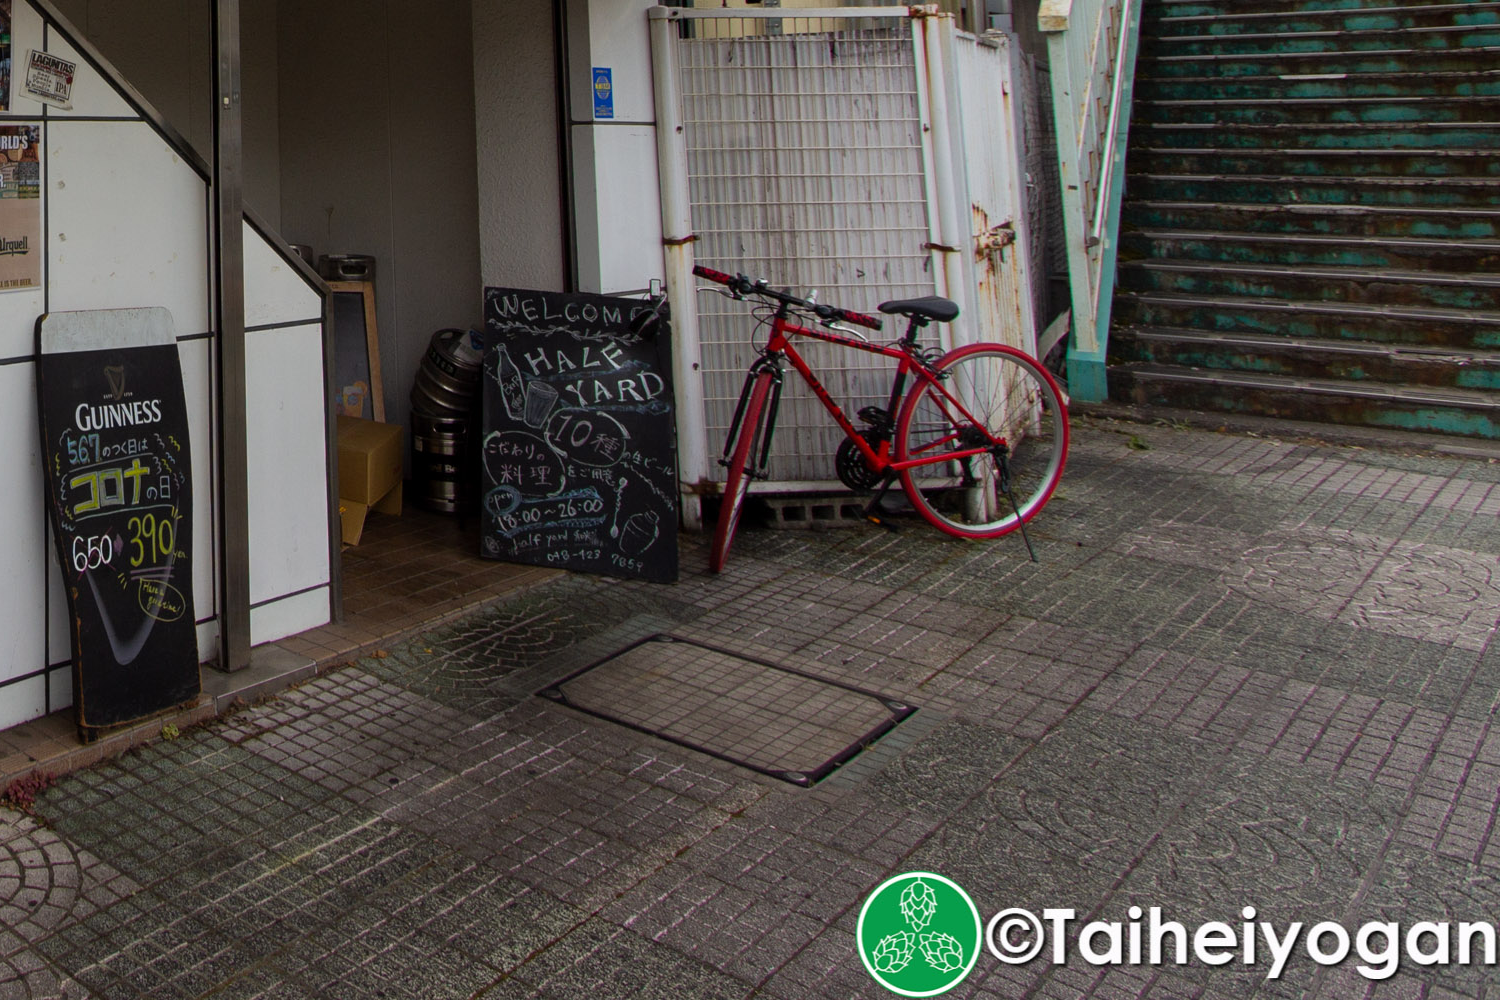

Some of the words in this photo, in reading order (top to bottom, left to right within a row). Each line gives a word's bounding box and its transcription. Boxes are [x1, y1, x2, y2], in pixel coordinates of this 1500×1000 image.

[32, 52, 74, 73] LAGUNITAS
[55, 81, 68, 95] IPA
[524, 342, 623, 376] HALF
[565, 370, 665, 408] YARD
[75, 399, 163, 432] GUINNESS
[70, 458, 171, 515] コロナの日
[500, 464, 553, 486] 料理
[72, 534, 113, 573] 650
[128, 513, 175, 568] 390
